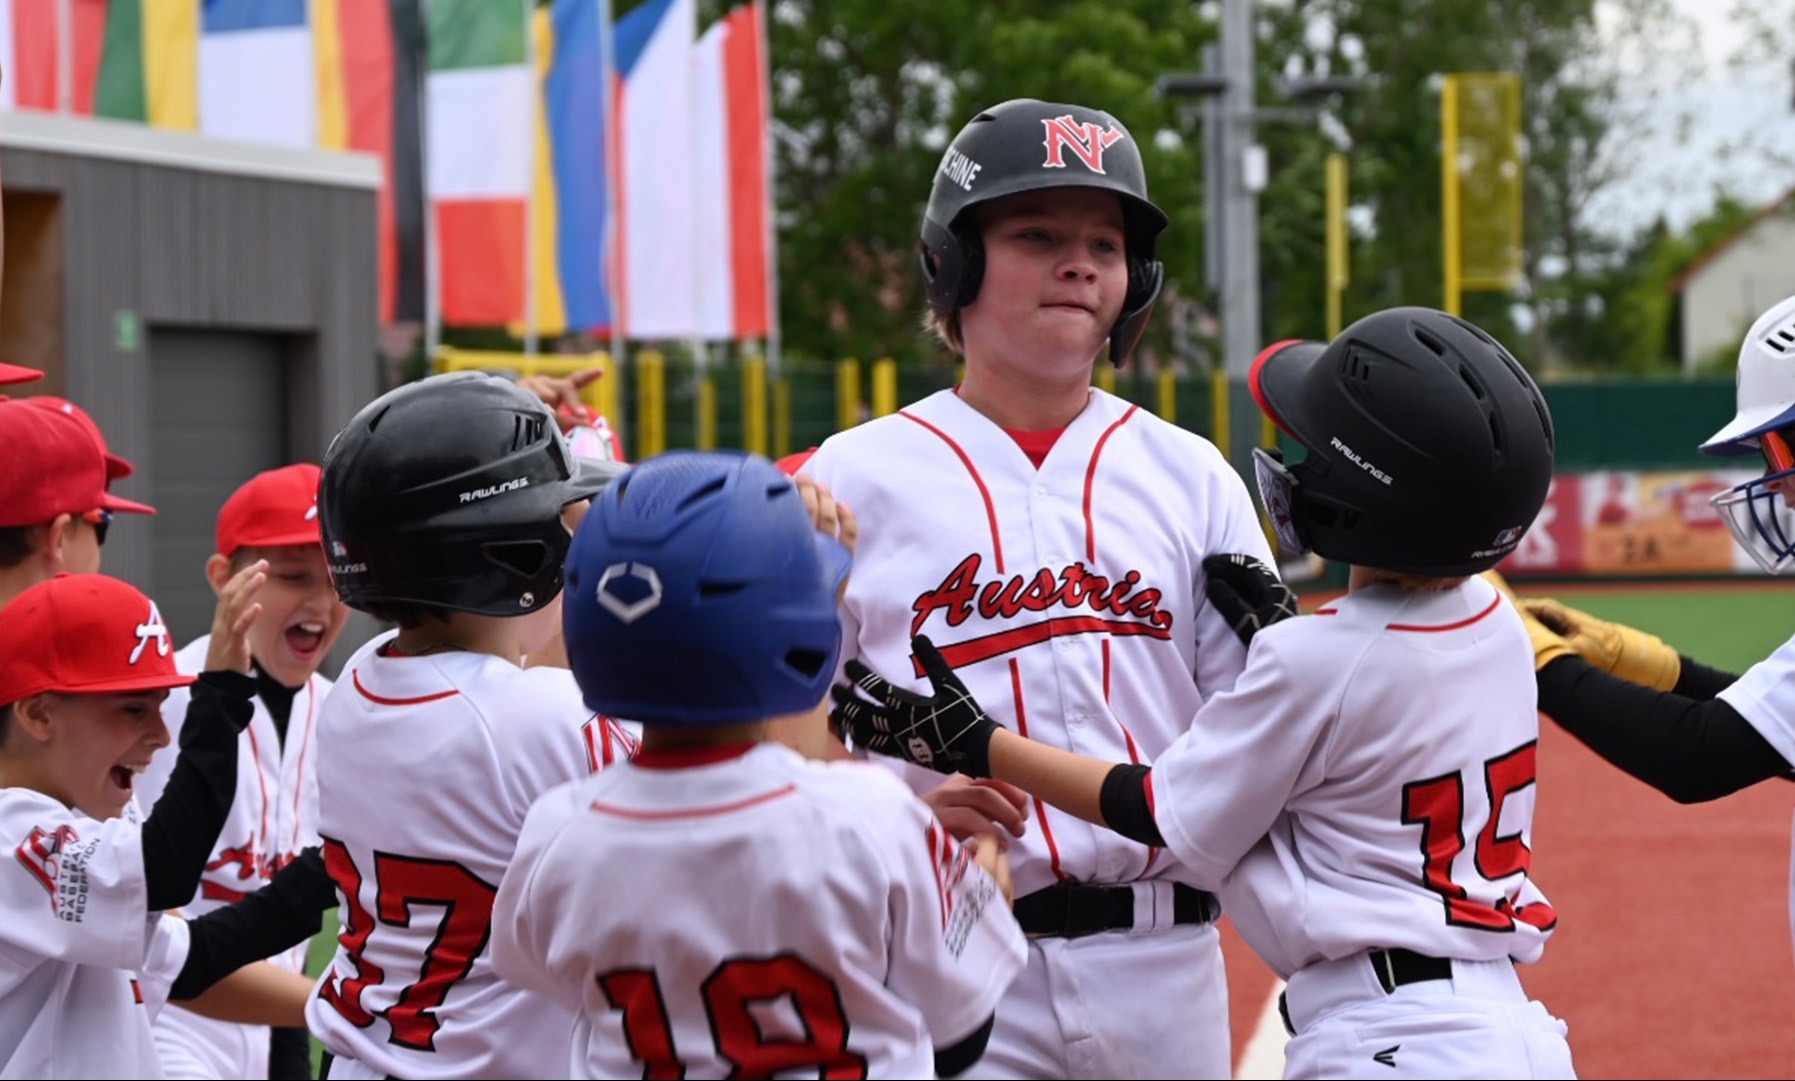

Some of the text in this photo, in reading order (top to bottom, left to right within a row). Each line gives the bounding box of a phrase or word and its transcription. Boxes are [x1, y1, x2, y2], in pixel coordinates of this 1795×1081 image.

[459, 476, 529, 503] RAWLINGS
[1330, 436, 1394, 486] RAWLINGS
[910, 552, 1173, 638] Austria
[129, 599, 169, 665] A
[75, 838, 101, 923] FEDERATION
